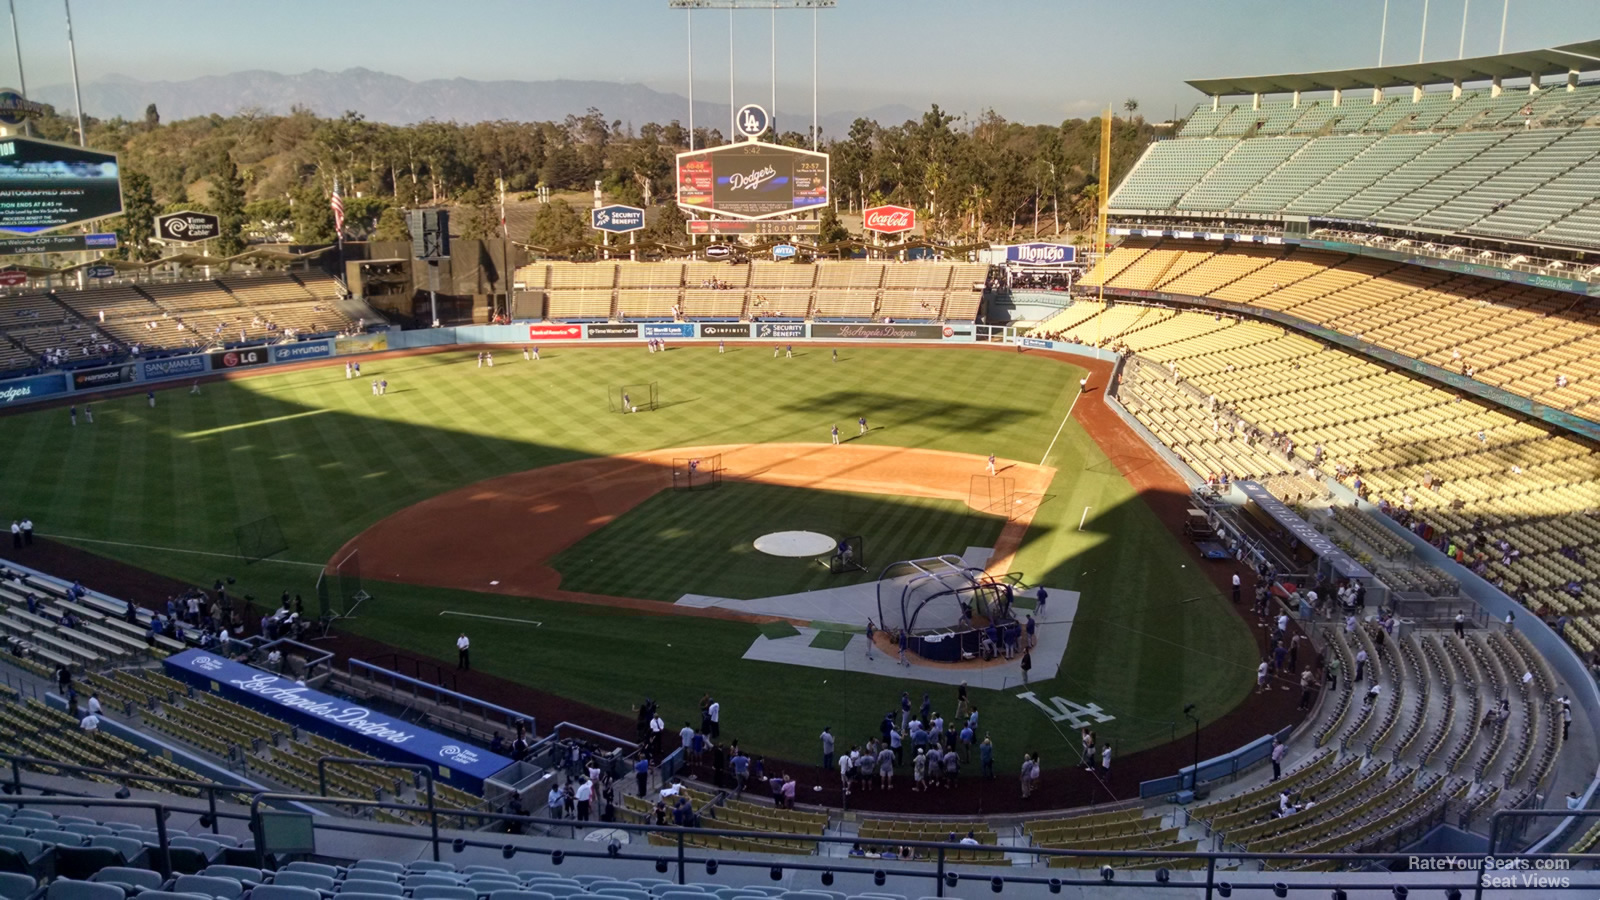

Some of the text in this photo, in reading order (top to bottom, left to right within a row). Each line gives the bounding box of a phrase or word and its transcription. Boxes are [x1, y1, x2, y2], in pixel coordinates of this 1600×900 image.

[744, 110, 760, 132] LA
[744, 146, 760, 154] 5:42
[730, 164, 776, 191] Dodgers
[868, 212, 910, 226] Coca-Cola
[1018, 246, 1064, 262] Montejo
[1535, 276, 1556, 288] Donate
[1556, 280, 1573, 291] Now!
[837, 326, 916, 337] Los Angeles Dodgers
[240, 352, 257, 363] LG
[292, 345, 328, 355] HYUNDAI
[145, 362, 163, 371] SAN
[168, 358, 202, 368] MANUEL
[1292, 524, 1340, 555] DODGER
[260, 687, 338, 716] Angeles
[324, 707, 414, 743] Dodgers
[1016, 691, 1116, 729] LA
